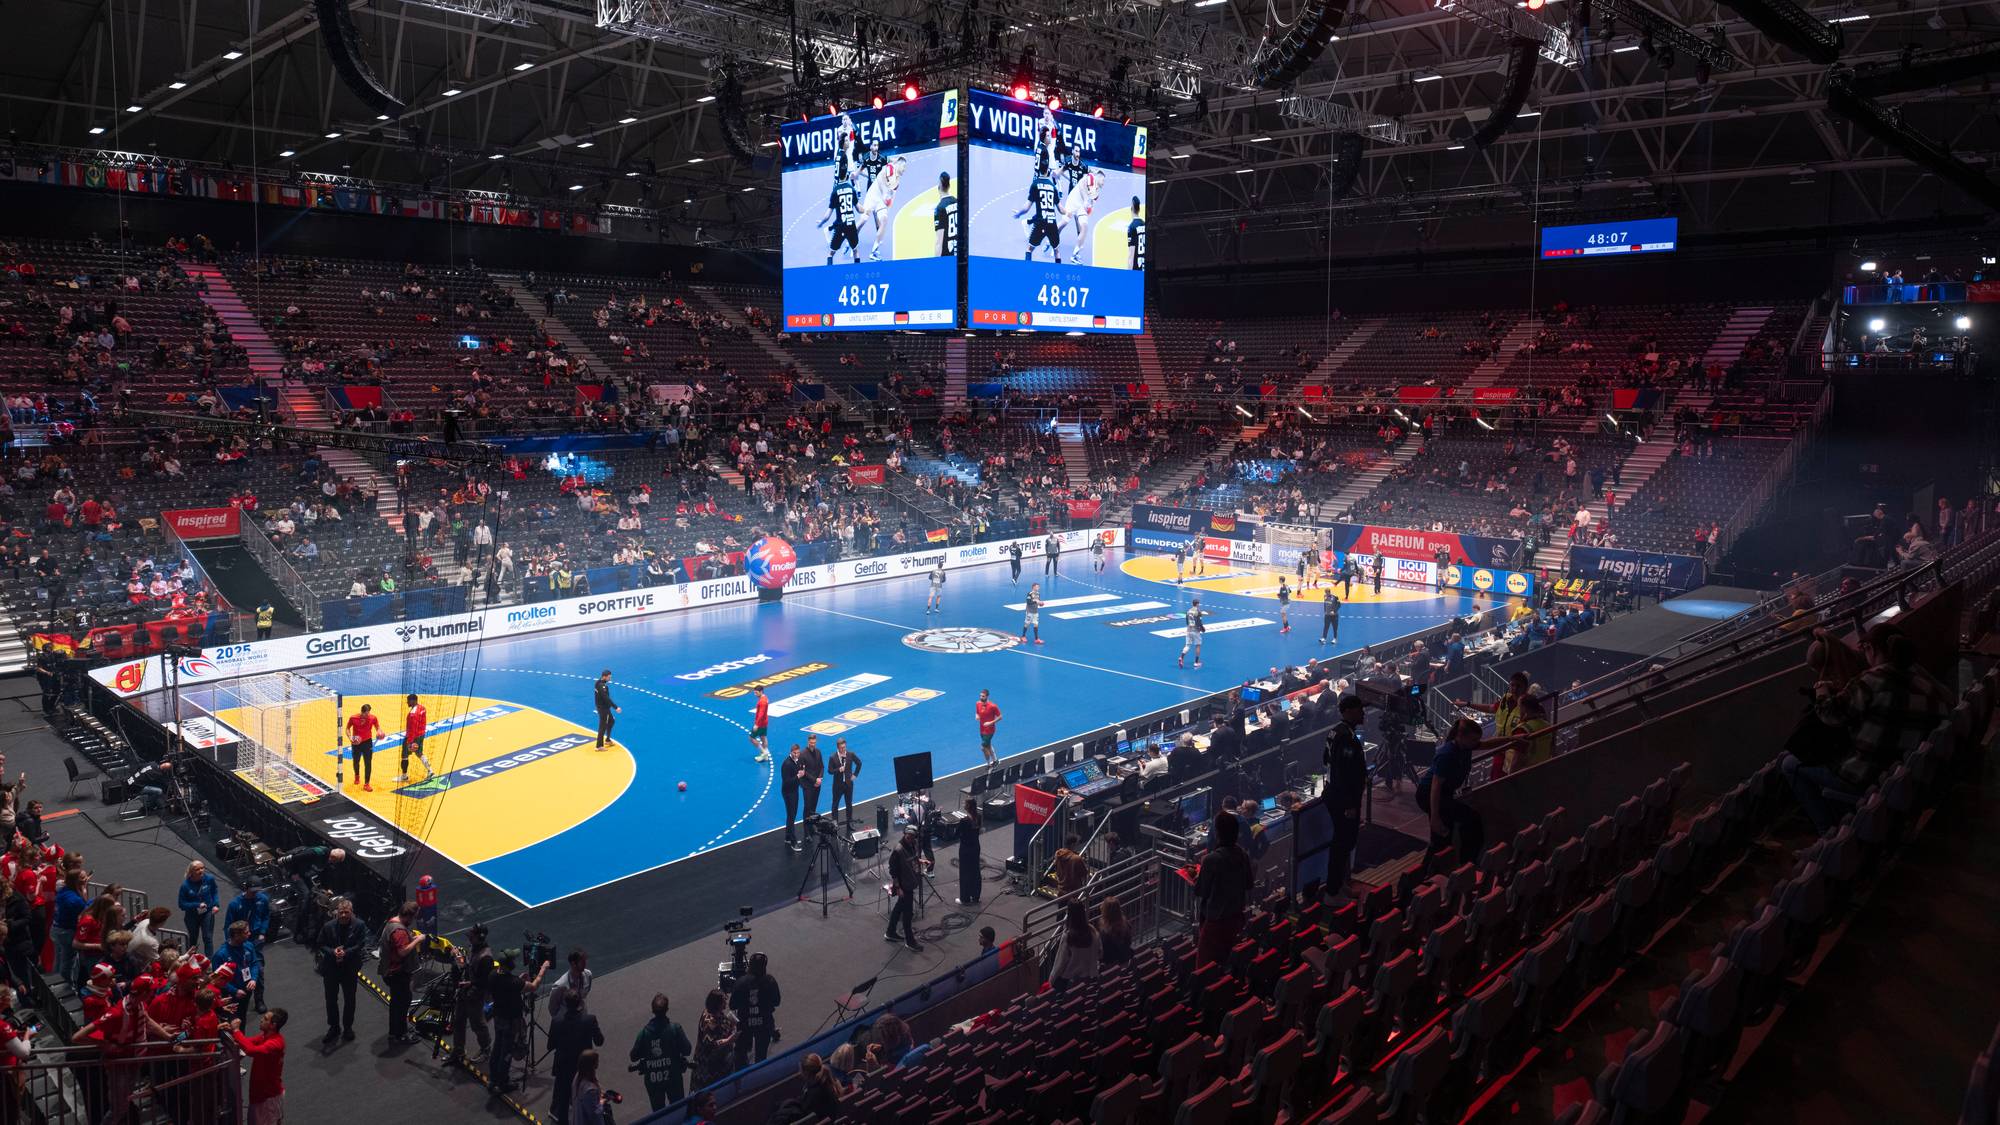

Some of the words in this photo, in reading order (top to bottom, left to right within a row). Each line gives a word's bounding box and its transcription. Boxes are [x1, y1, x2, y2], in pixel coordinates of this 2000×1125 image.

[970, 103, 984, 130] Y
[989, 107, 1097, 152] WOREAR
[782, 135, 792, 158] Y
[796, 116, 896, 156] WOREAR
[1588, 232, 1628, 245] 48:07
[838, 283, 890, 307] 48:07
[1037, 284, 1090, 308] 48:07
[795, 316, 813, 325] POR
[920, 312, 942, 322] GER
[984, 312, 1007, 322] POR
[177, 513, 227, 528] inspired
[1148, 510, 1191, 527] inspired
[1135, 537, 1184, 549] GRUNDFOS
[1205, 543, 1229, 552] ett1.de
[1235, 542, 1246, 550] Wir
[1371, 533, 1424, 550] BAERUM
[913, 552, 947, 568] hummel
[960, 546, 987, 558] molten
[855, 561, 887, 575] Gerflor
[1400, 560, 1425, 572] LIQUI
[1400, 570, 1426, 581] MOLY
[702, 580, 747, 600] OFFICIAL
[578, 594, 654, 615] SPORTFIVE
[507, 606, 556, 622] molten
[419, 616, 482, 640] hummel
[306, 634, 370, 655] Gerflor
[674, 653, 773, 681] brother
[744, 663, 828, 688] HARTING
[460, 736, 588, 779] freenet
[323, 816, 407, 858] Gerflor
[647, 1057, 671, 1069] PHOTO
